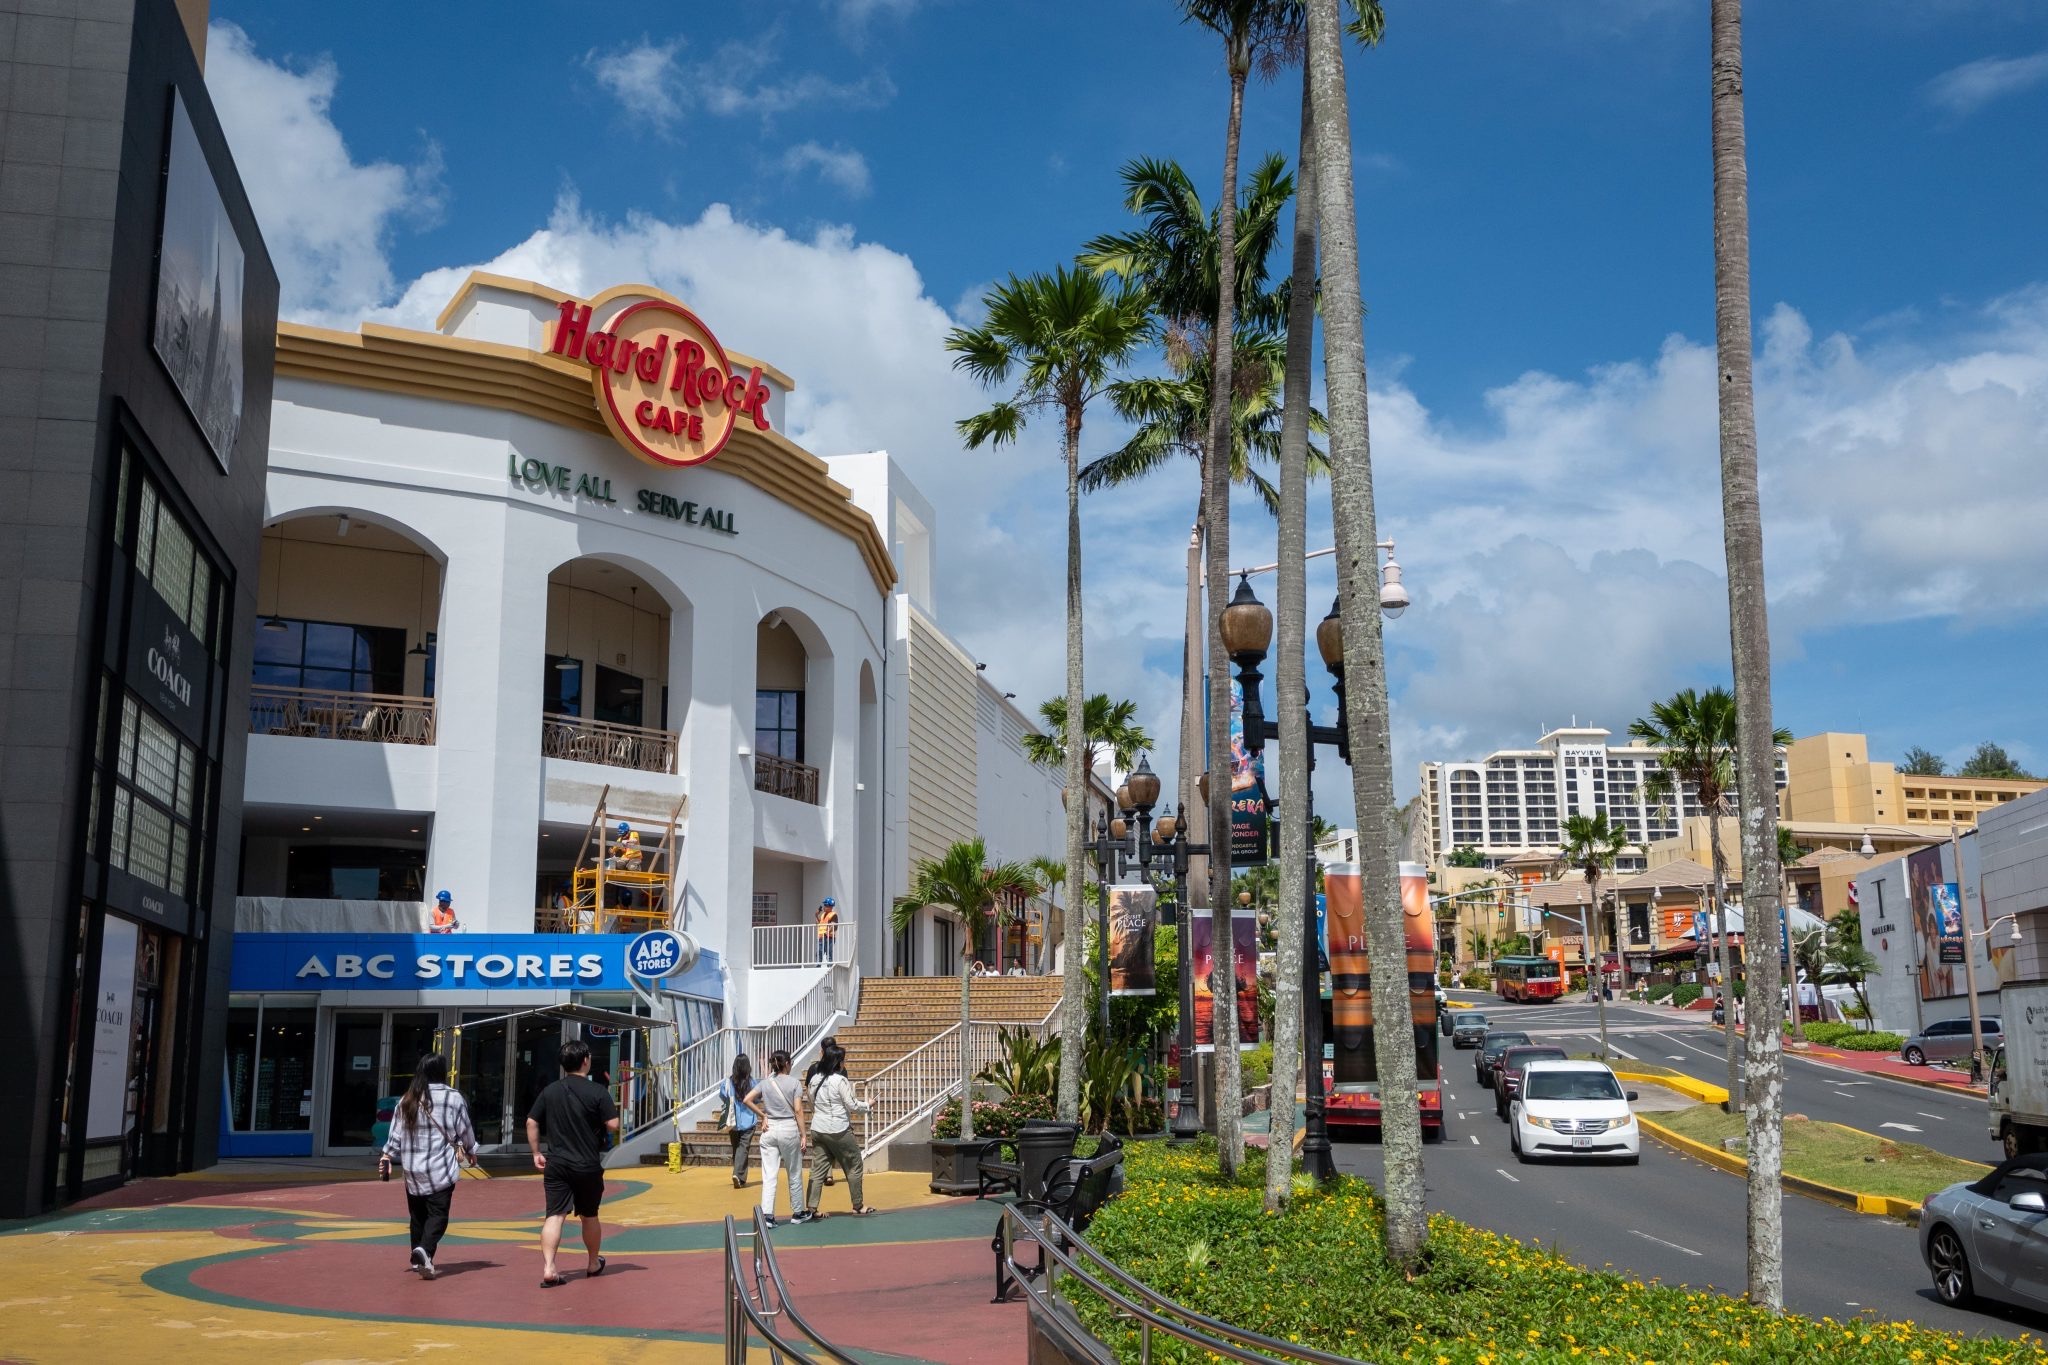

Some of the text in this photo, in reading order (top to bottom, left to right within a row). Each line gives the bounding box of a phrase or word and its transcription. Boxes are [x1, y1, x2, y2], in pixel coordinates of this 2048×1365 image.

[551, 299, 771, 431] Hard Rock
[635, 400, 703, 442] CAFE
[508, 454, 739, 535] LOVE ALL SERVE ALL
[147, 647, 191, 707] COACH
[142, 895, 164, 915] COACH
[1870, 878, 1886, 918] T
[1117, 918, 1146, 928] PLACE
[635, 937, 674, 960] ABC
[296, 954, 602, 978] ABC STORES
[637, 957, 672, 971] STORES
[96, 1007, 123, 1026] COACH
